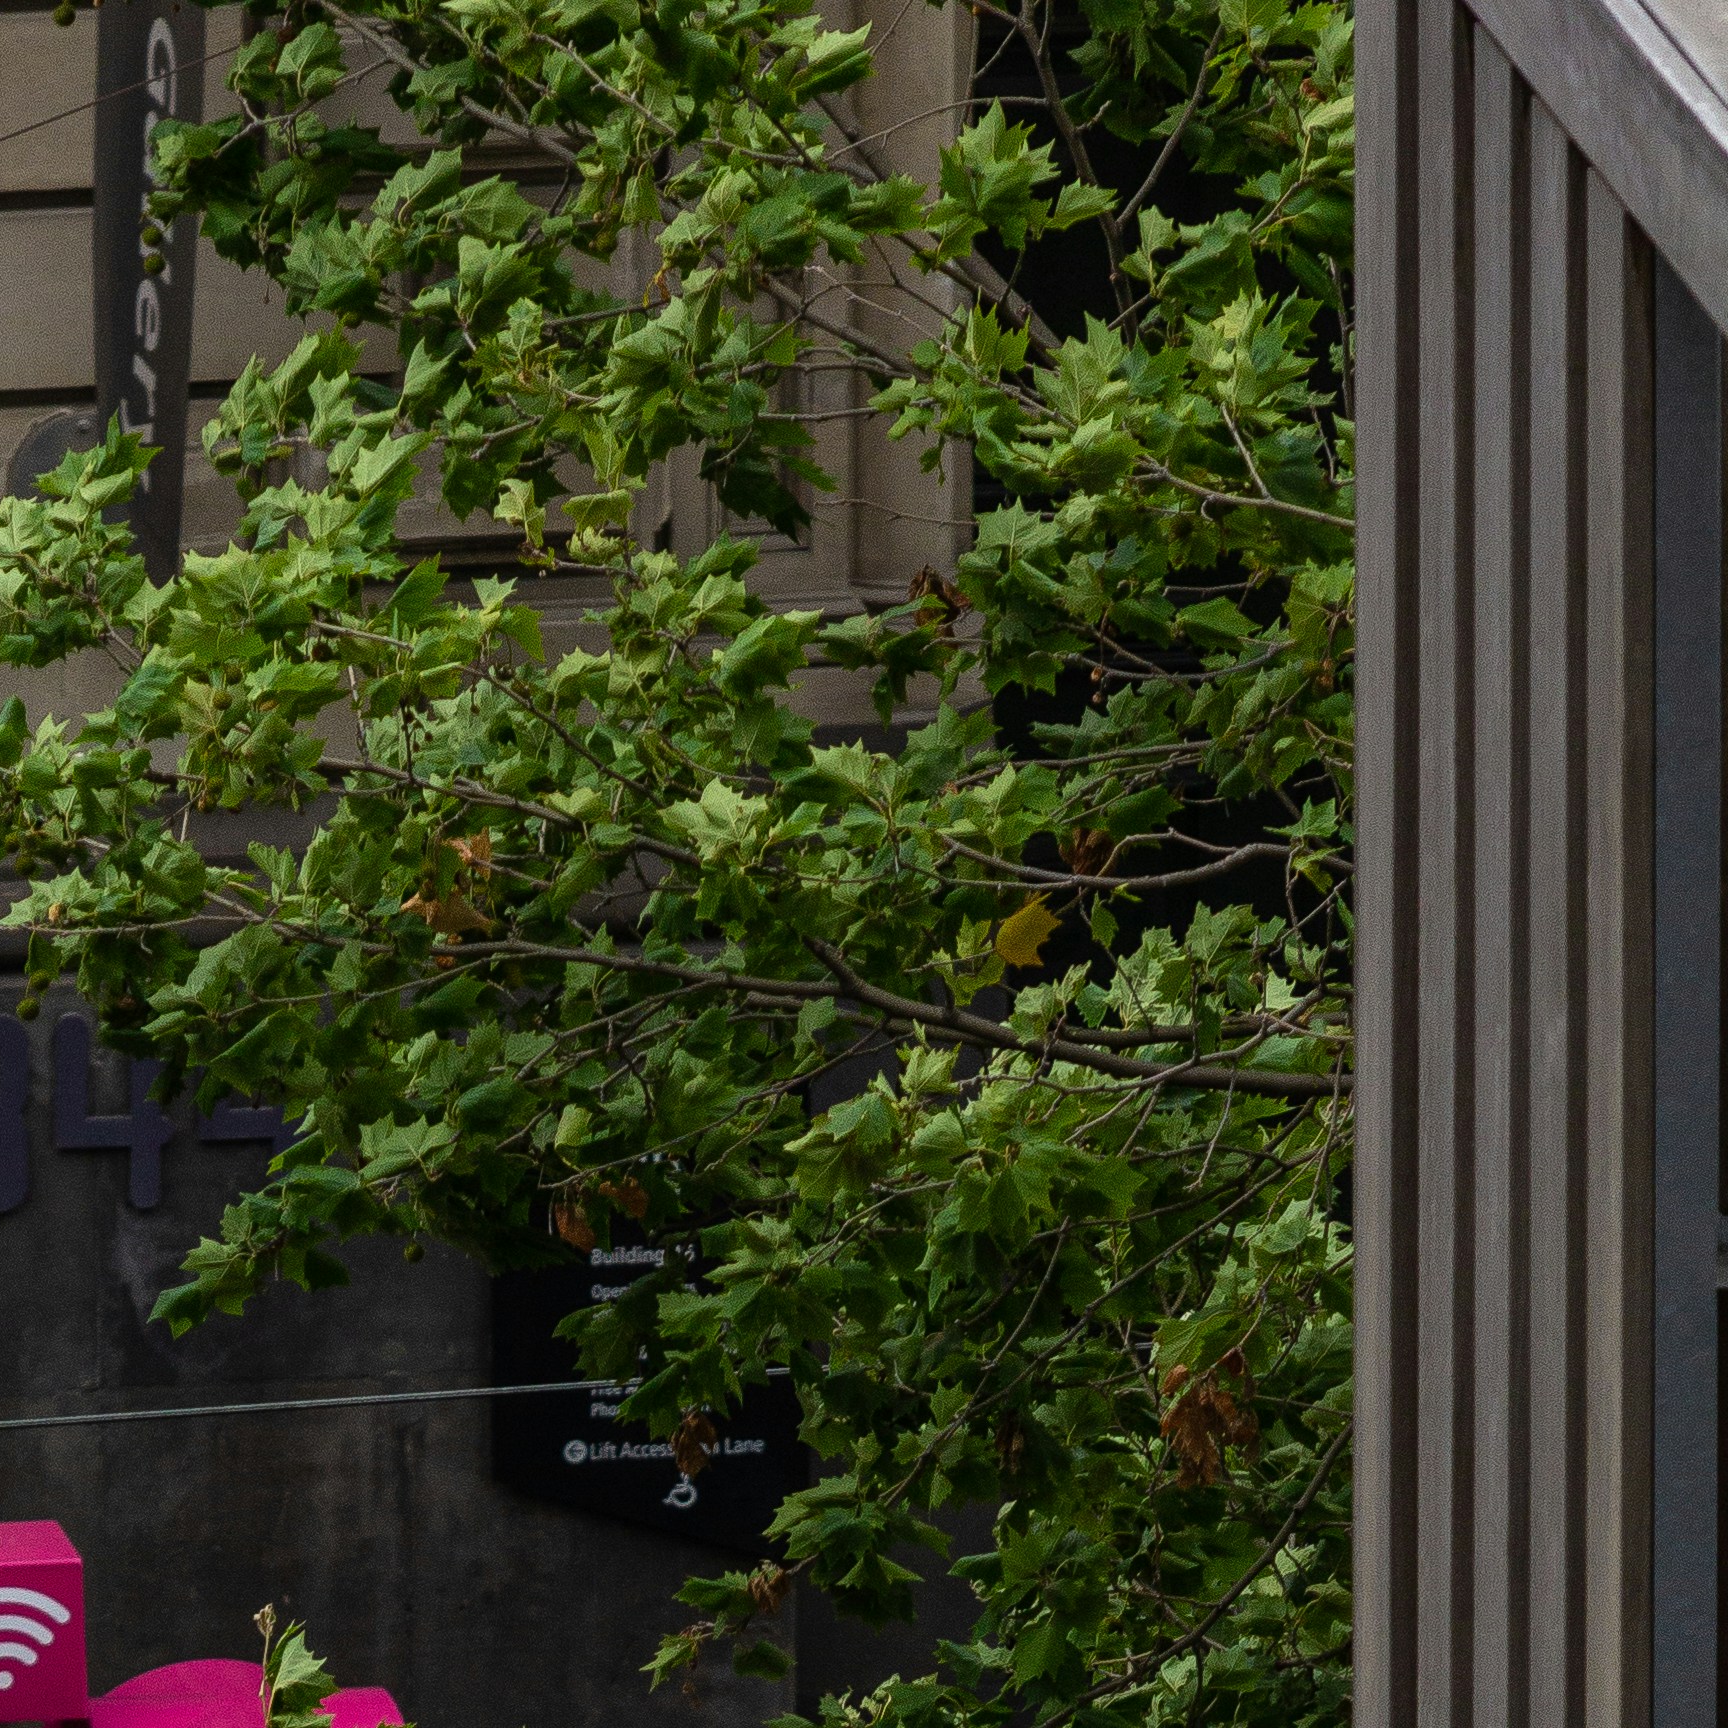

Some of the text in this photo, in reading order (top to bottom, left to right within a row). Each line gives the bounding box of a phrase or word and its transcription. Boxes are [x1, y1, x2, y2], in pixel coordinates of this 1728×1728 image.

[590, 1246, 665, 1267] Building
[589, 1440, 617, 1461] Lift
[724, 1436, 766, 1456] Lane
